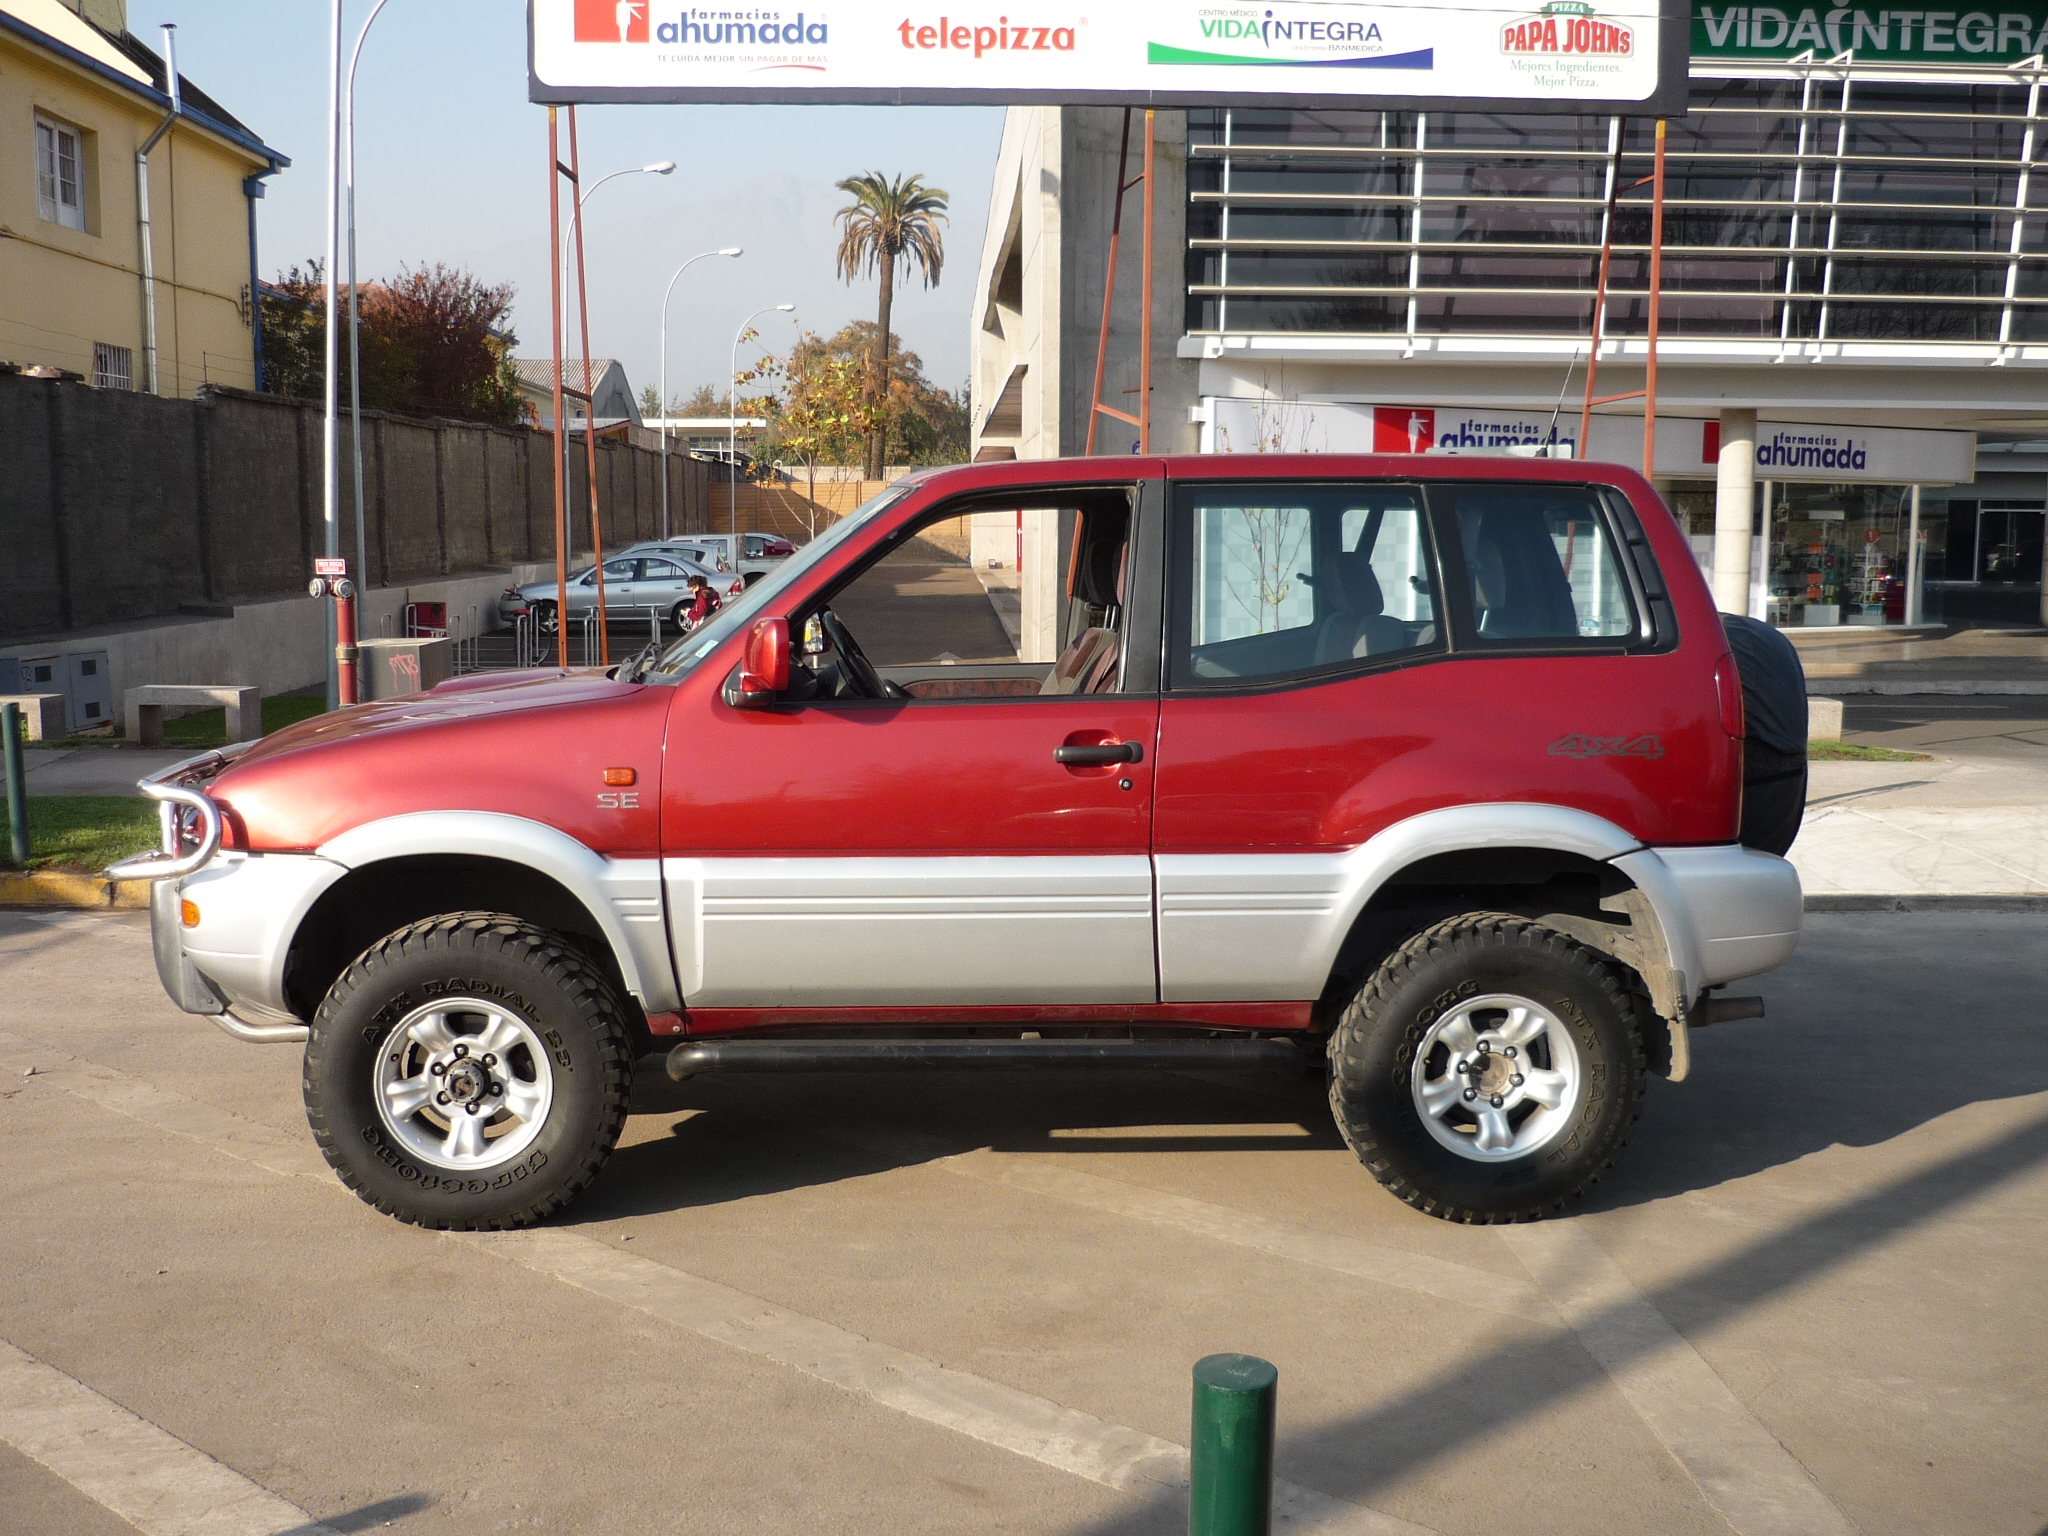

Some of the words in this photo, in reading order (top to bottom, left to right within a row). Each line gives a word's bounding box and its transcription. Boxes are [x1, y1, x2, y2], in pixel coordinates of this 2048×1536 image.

[690, 8, 781, 20] farmacias
[1198, 9, 1229, 17] CENTRO
[1229, 9, 1258, 18] MÉDICO
[1551, 3, 1585, 13] PIZZA
[656, 12, 828, 45] ahumada
[1503, 18, 1559, 52] PAPA
[1562, 18, 1631, 55] JOHN'S
[897, 16, 1075, 59] telepizza
[1328, 44, 1383, 53] BANMEDICA
[671, 55, 701, 63] CUIDA
[704, 55, 736, 63] MEJOR
[739, 55, 754, 63] SIN
[757, 55, 788, 63] PAGAR
[792, 55, 803, 63] DE
[807, 53, 828, 63] MÁS
[1510, 59, 1552, 73] Mejores
[1555, 60, 1623, 75] Ingredientes.
[1533, 75, 1566, 89] Mejor
[1569, 76, 1600, 87] Pizza.
[1468, 418, 1540, 435] farmacias
[1779, 432, 1838, 447] farmacias
[1756, 435, 1866, 470] ahumada
[597, 792, 640, 809] SE
[361, 992, 412, 1045] ATX
[422, 977, 541, 1023] RADIAL
[1556, 997, 1601, 1051] ATX
[1547, 1063, 1606, 1164] RADIAL
[360, 1125, 548, 1194] Firestone
